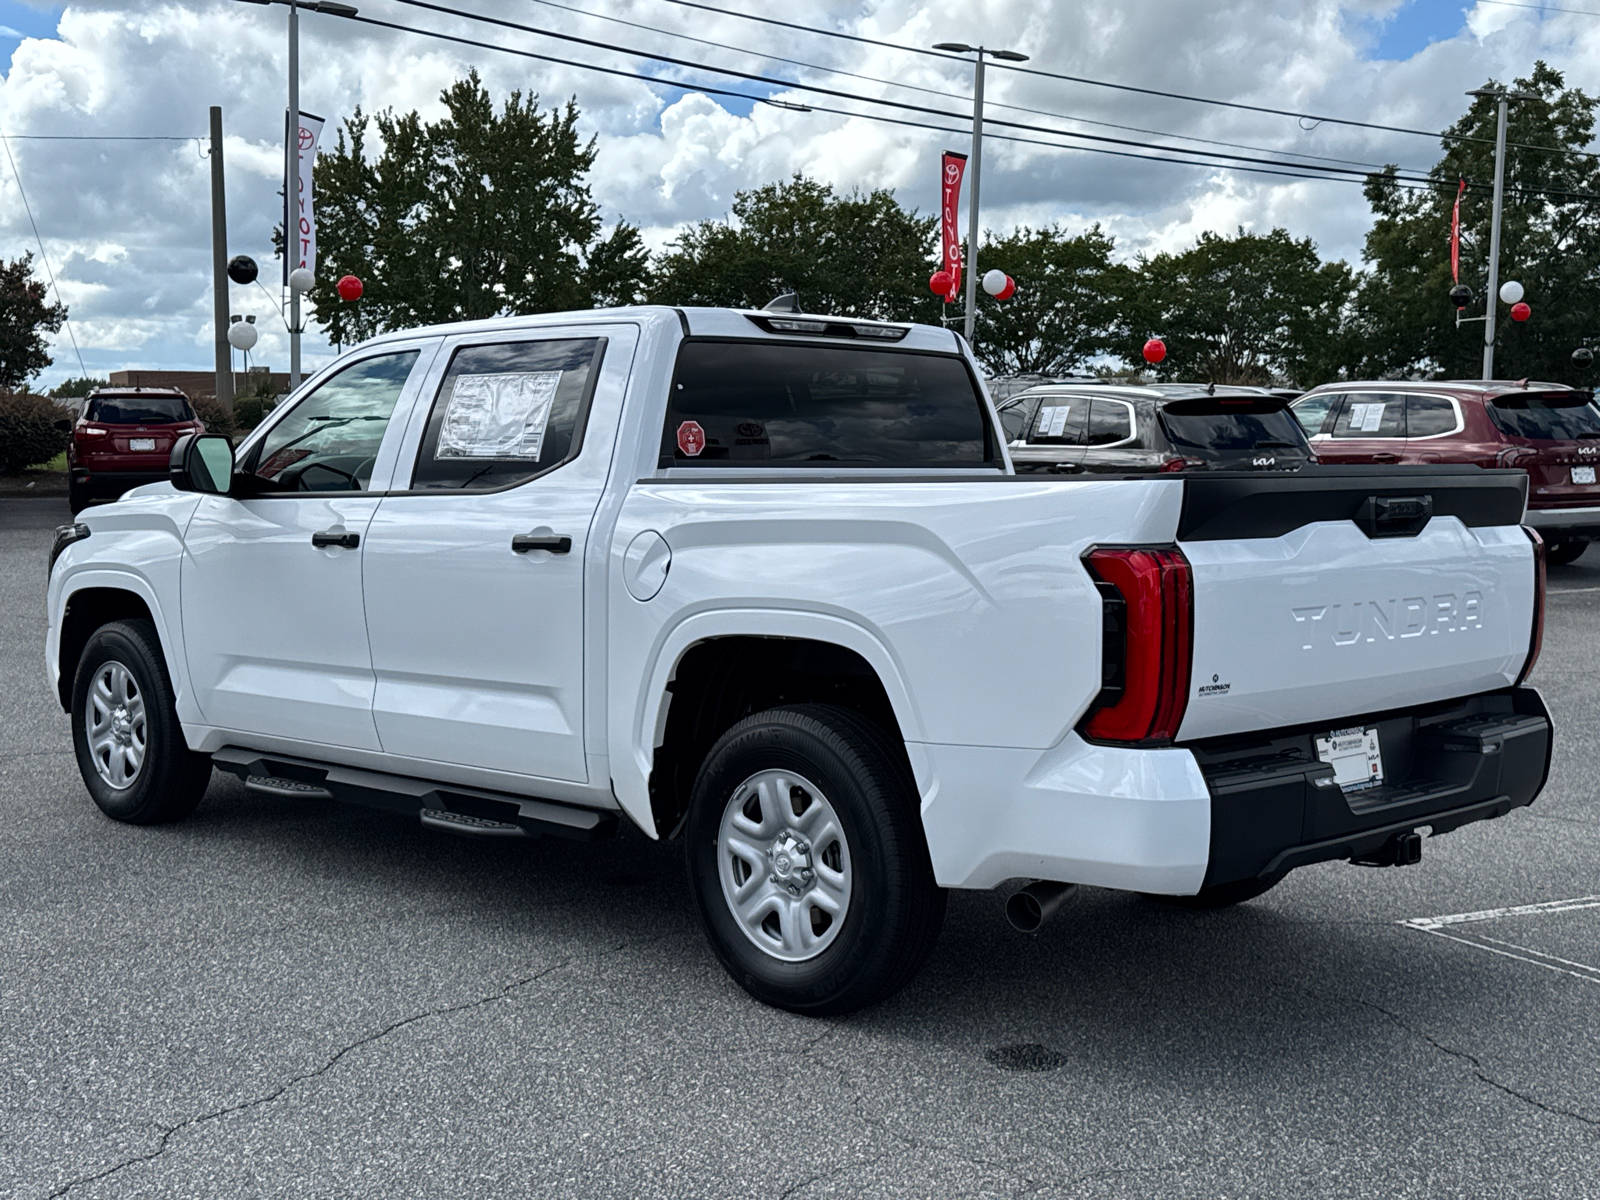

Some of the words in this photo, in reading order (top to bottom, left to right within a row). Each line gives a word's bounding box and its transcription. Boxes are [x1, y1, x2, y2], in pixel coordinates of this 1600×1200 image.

[945, 188, 958, 299] TOYOTA
[1291, 590, 1484, 651] TUNDRA
[1199, 684, 1231, 692] HUTCHINSON
